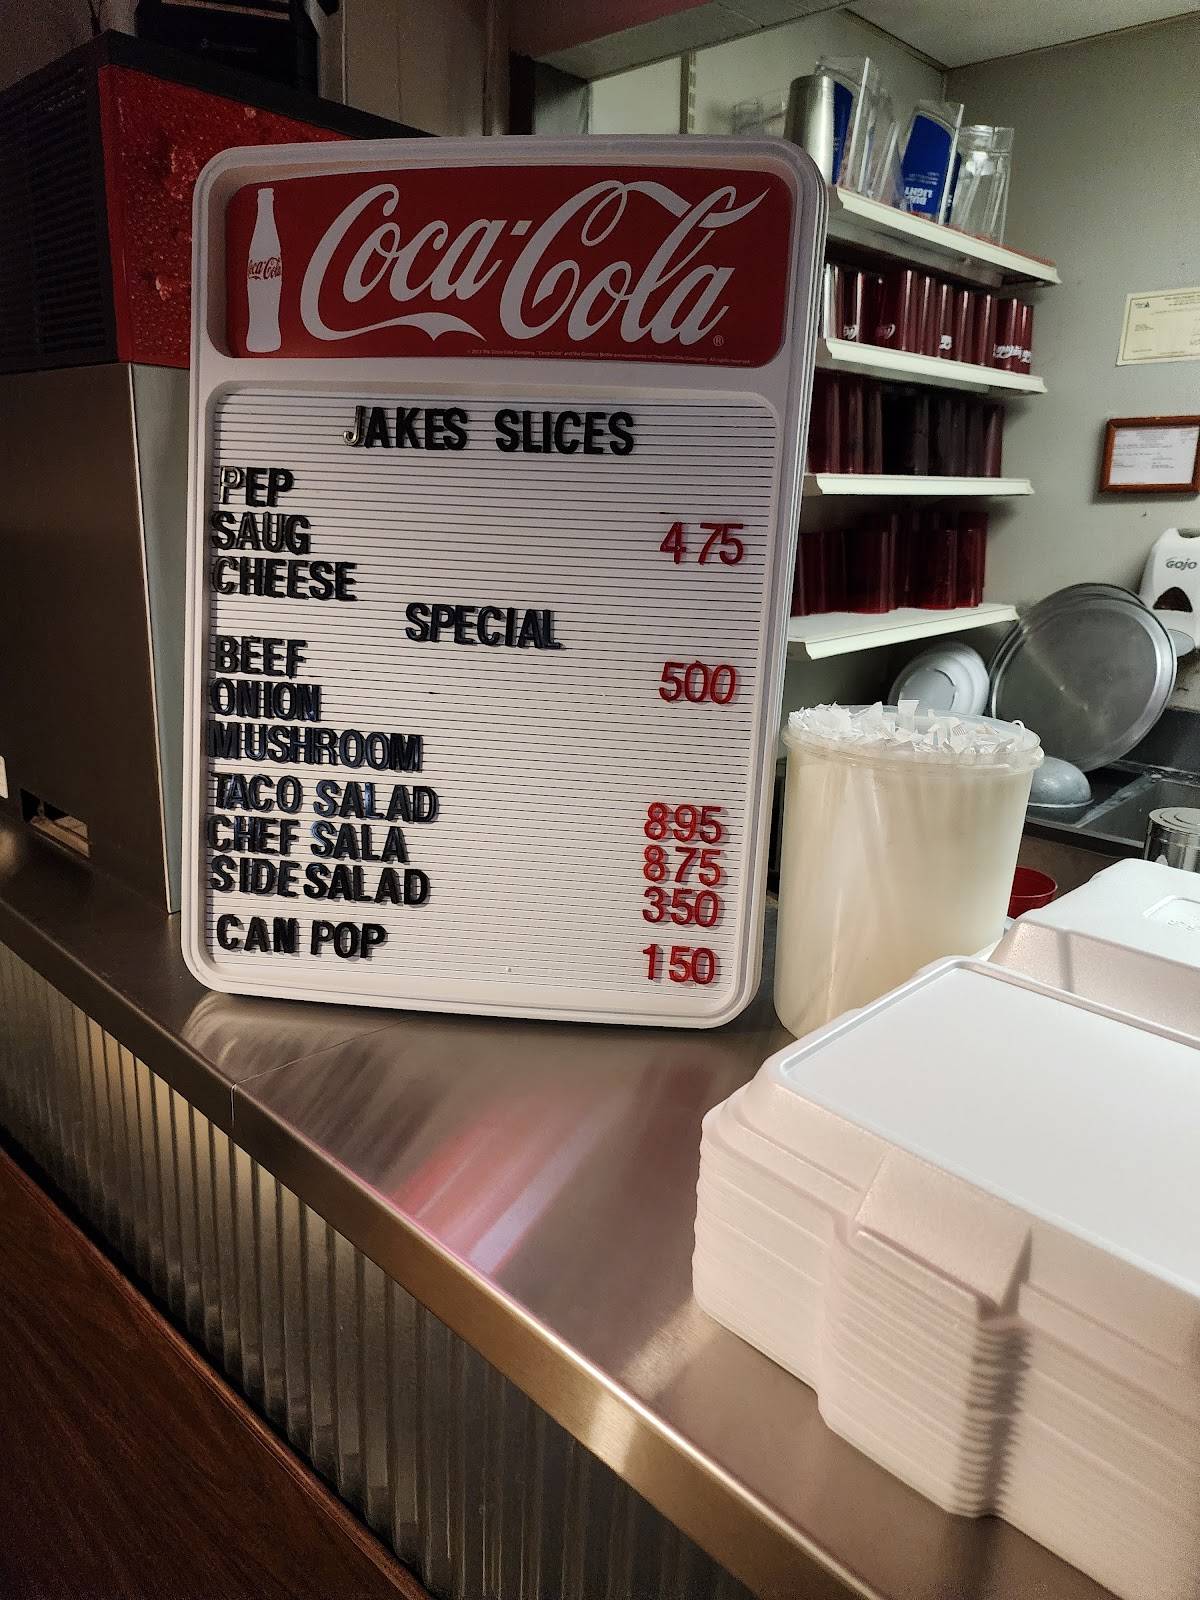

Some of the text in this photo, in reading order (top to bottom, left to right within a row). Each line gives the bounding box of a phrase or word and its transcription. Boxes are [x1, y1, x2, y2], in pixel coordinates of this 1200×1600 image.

[300, 179, 769, 347] Coca-Cola
[343, 405, 634, 455] JAKES SLICES
[219, 465, 295, 507] PEP
[211, 511, 311, 555] SAUG
[212, 556, 358, 600] CHEESE
[405, 602, 564, 650] SPECIAL
[214, 635, 308, 678] BEEF
[210, 678, 321, 722] ONION
[659, 660, 737, 704] 500
[208, 720, 423, 773] MUSHROOM
[211, 772, 440, 823] TACO SALAD
[208, 815, 410, 864] CHEF SALA
[644, 802, 723, 844] 895
[643, 844, 721, 886] 875
[642, 886, 719, 927] 350
[216, 914, 388, 959] CAN POP
[643, 944, 715, 985] 150
